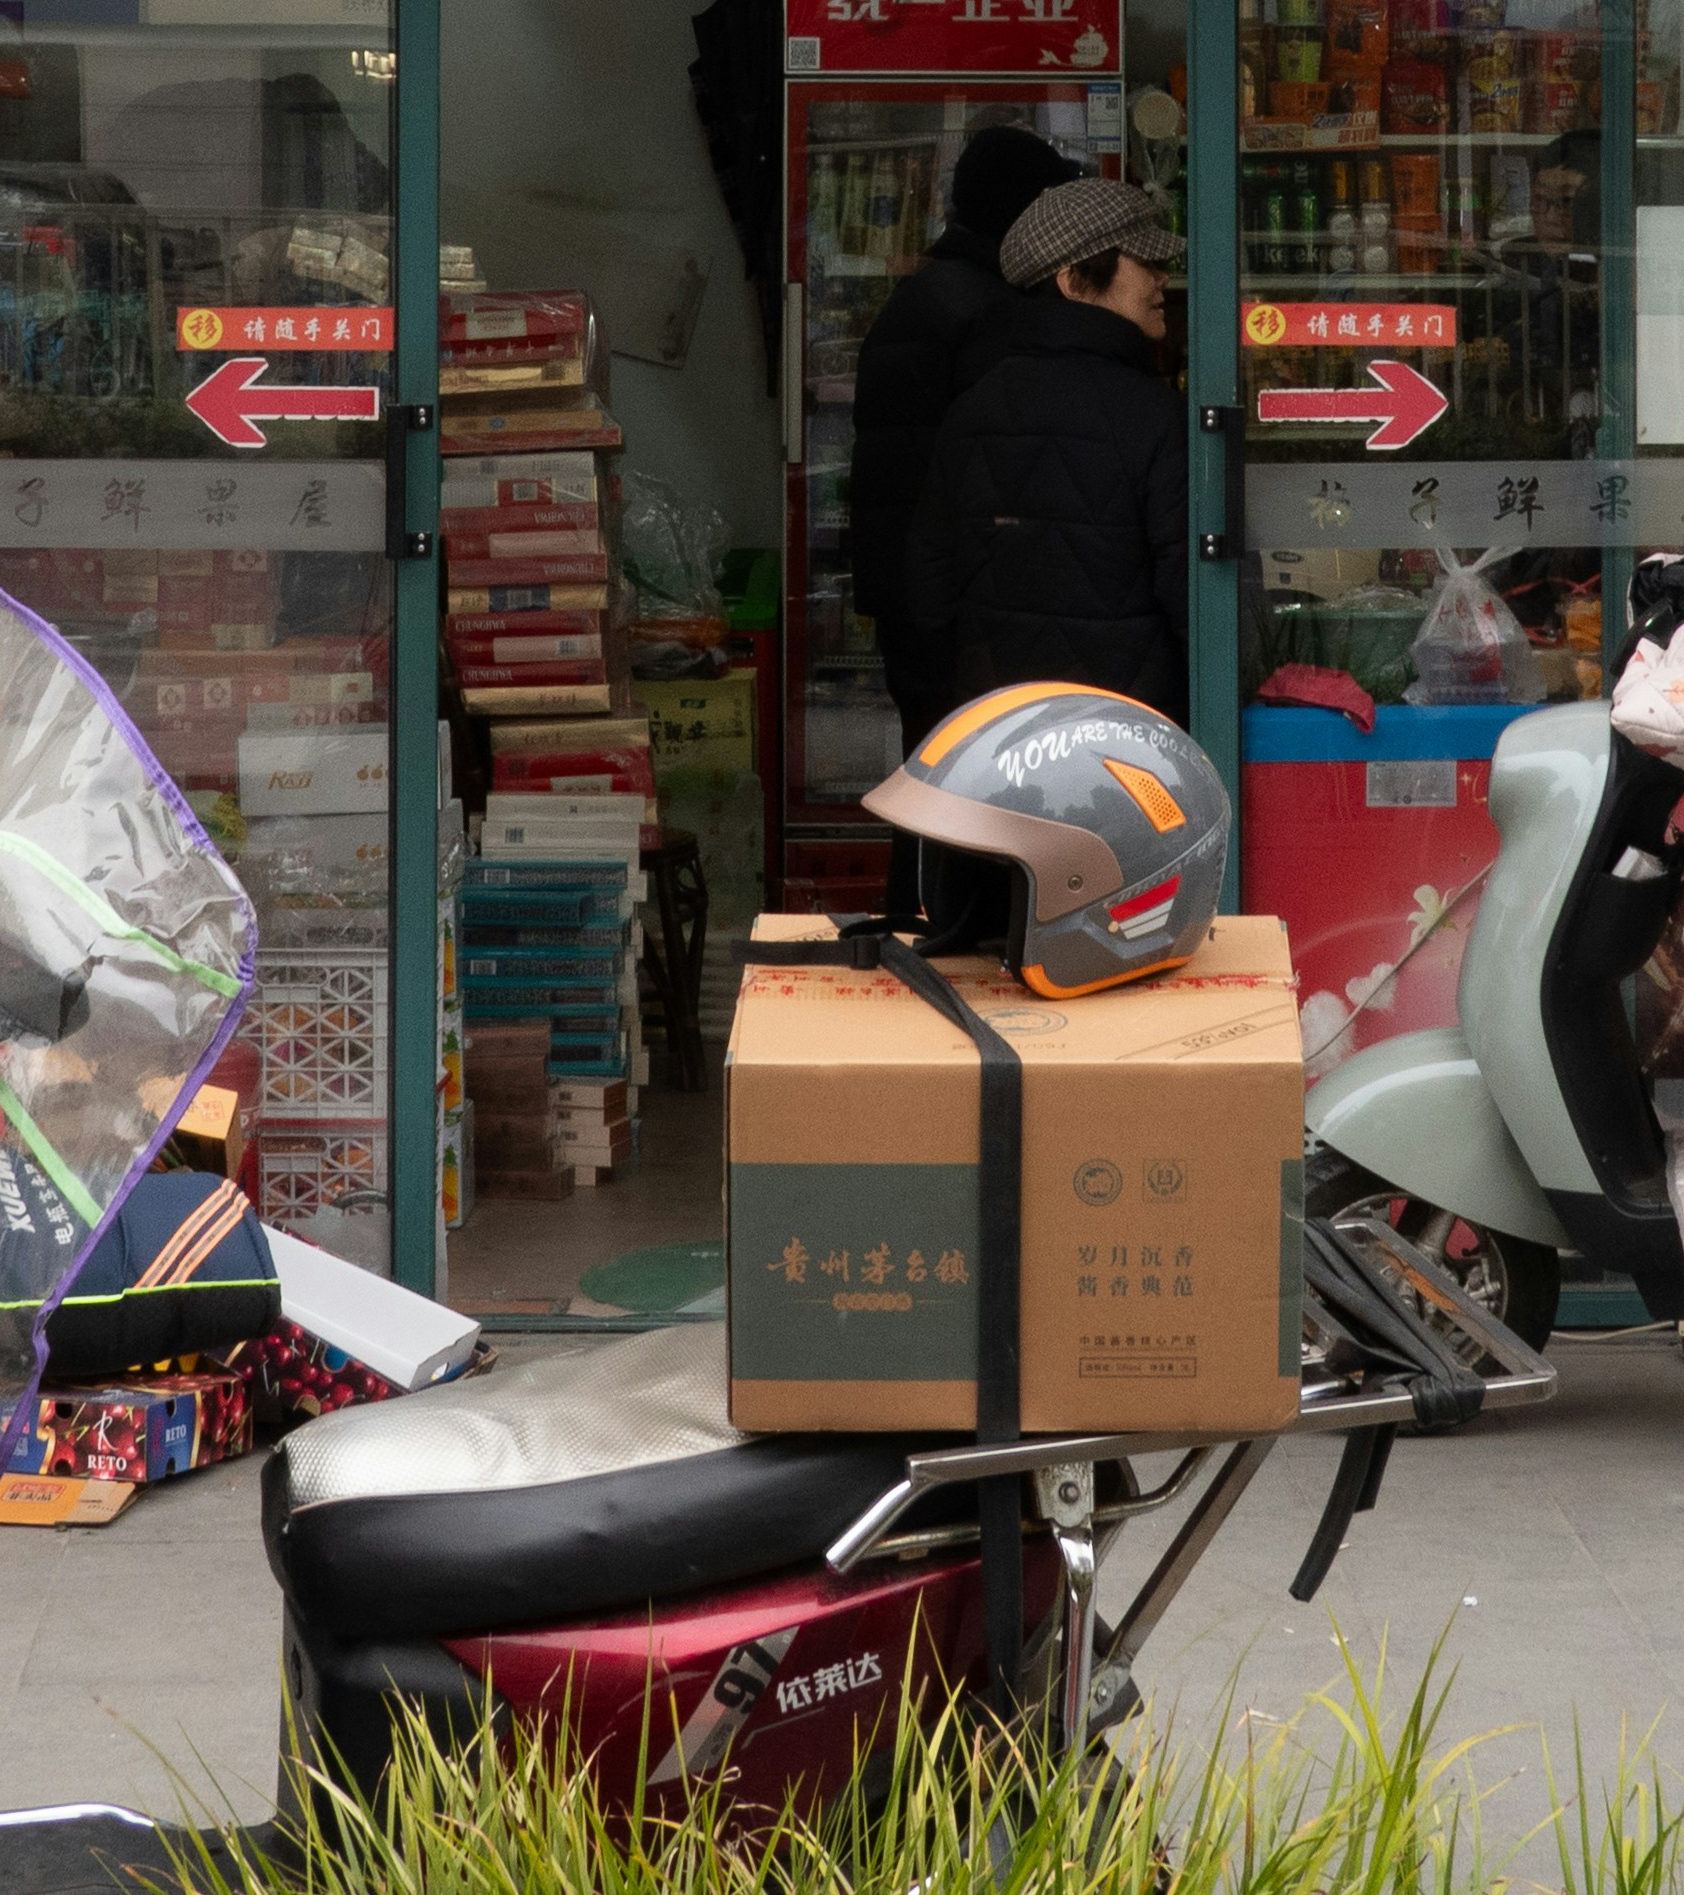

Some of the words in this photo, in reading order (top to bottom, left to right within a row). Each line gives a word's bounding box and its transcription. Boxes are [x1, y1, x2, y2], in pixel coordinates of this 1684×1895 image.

[241, 317, 383, 344] 请随手关门
[1306, 311, 1444, 339] 请随手关门
[998, 728, 1071, 787] YOU
[1071, 722, 1107, 749] ARE
[1109, 722, 1145, 743] THE
[766, 1236, 970, 1285] 贵州茅台镇
[1078, 1246, 1193, 1267] 岁月沉香
[1078, 1275, 1193, 1297] 酱香典范
[165, 1425, 187, 1443] RETO
[87, 1455, 127, 1472] RETO
[776, 1652, 883, 1714] 依莱达
